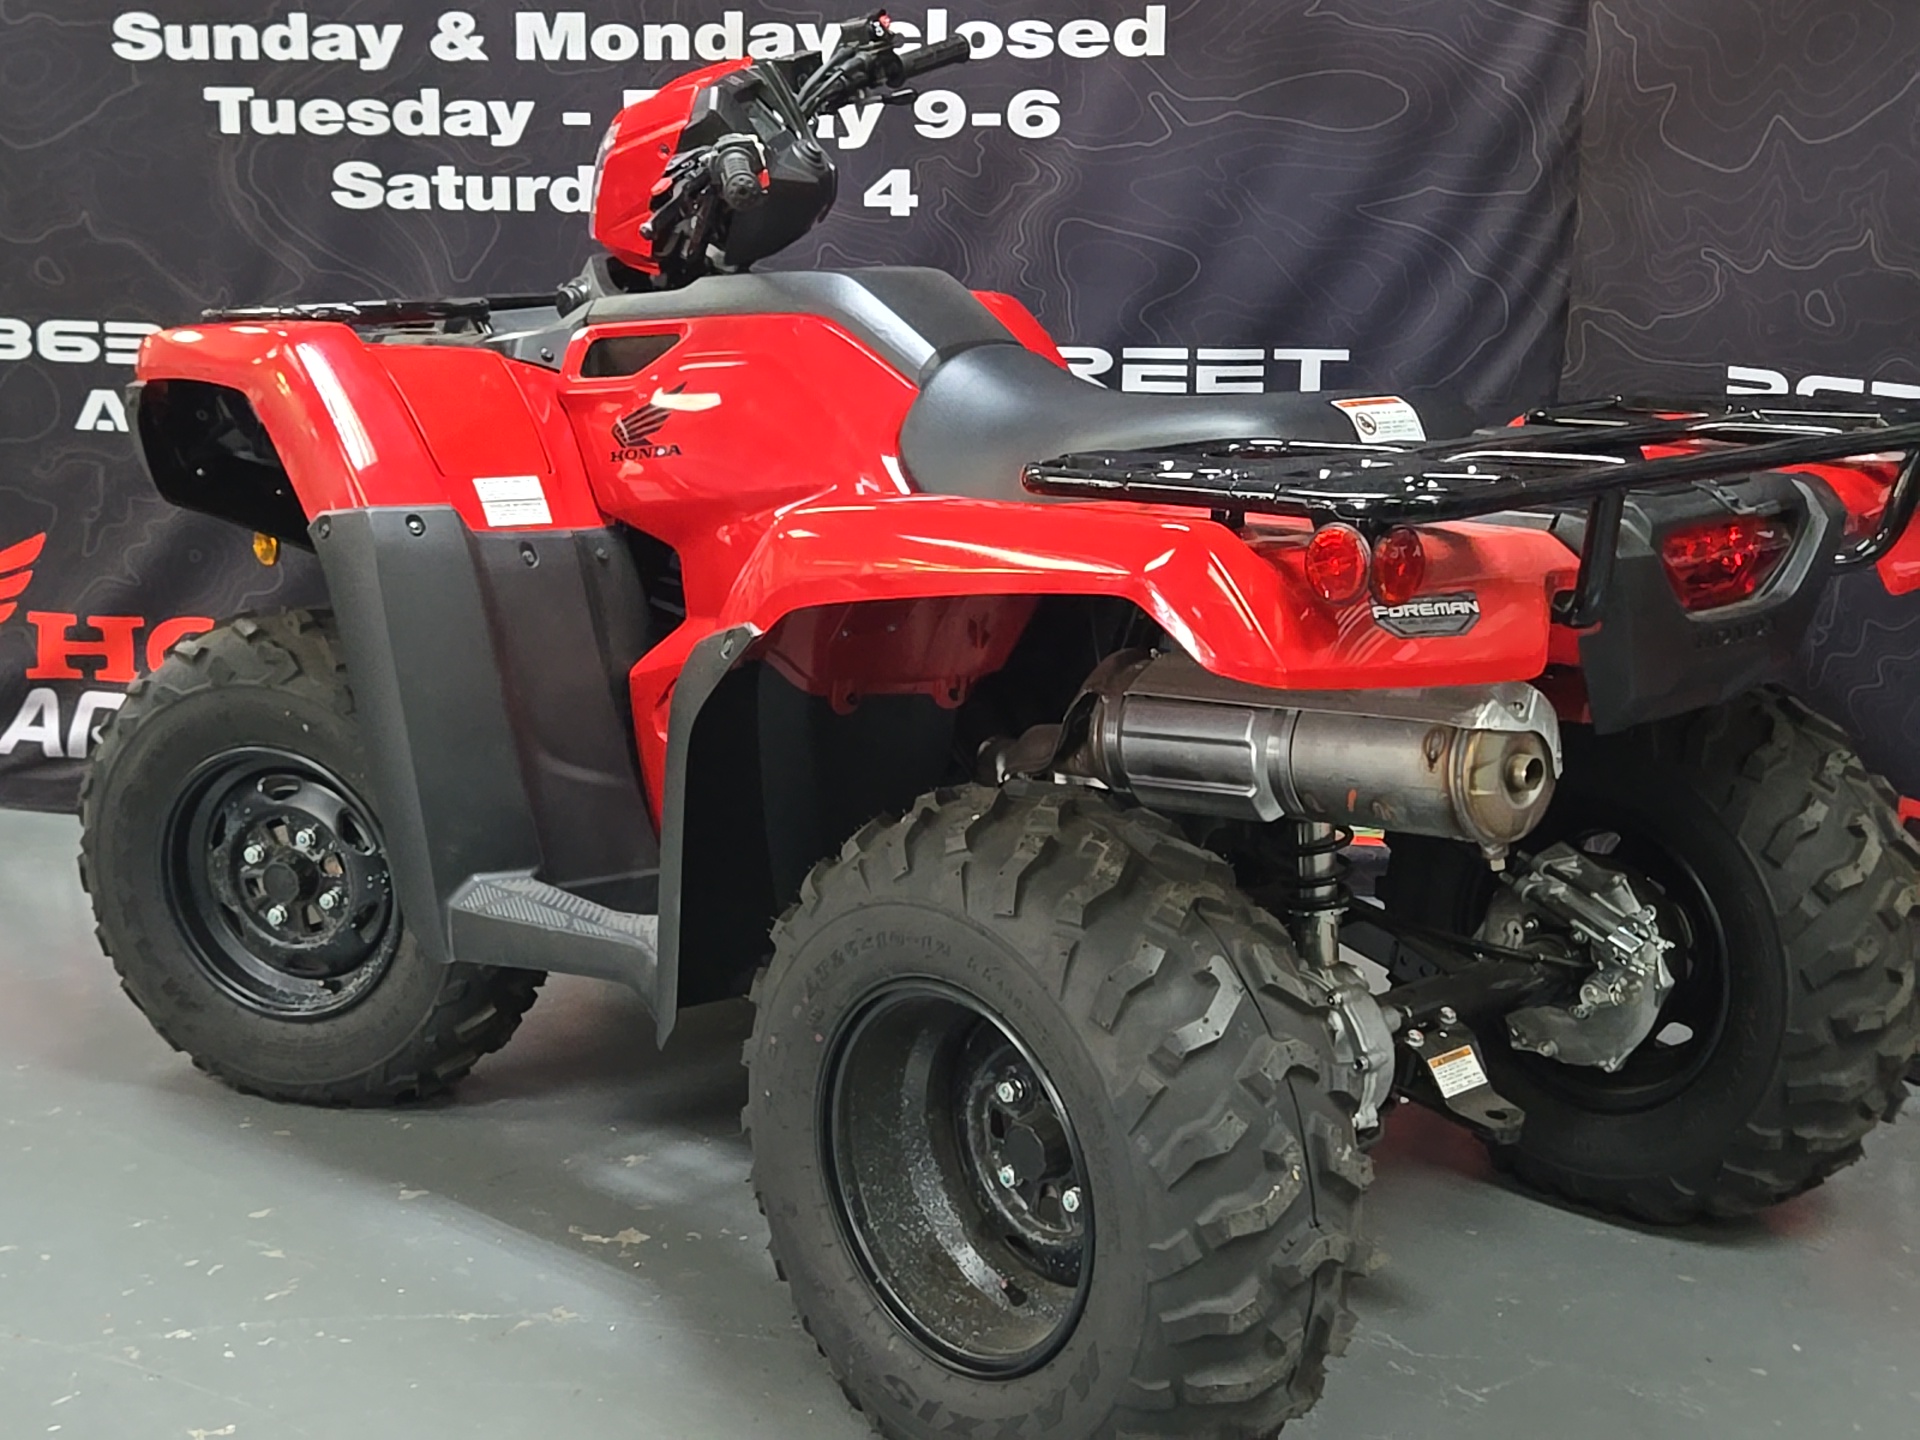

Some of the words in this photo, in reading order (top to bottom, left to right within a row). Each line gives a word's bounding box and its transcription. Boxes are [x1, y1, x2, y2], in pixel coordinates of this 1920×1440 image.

[111, 11, 404, 71] Sunday
[429, 11, 490, 62] &
[514, 10, 842, 62] Monday
[888, 4, 1166, 59] closed
[203, 86, 535, 147] Tuesday
[913, 88, 1061, 139] 9-6
[330, 160, 596, 212] Saturd
[610, 444, 682, 463] HONDA
[1371, 600, 1480, 619] FOREMAN
